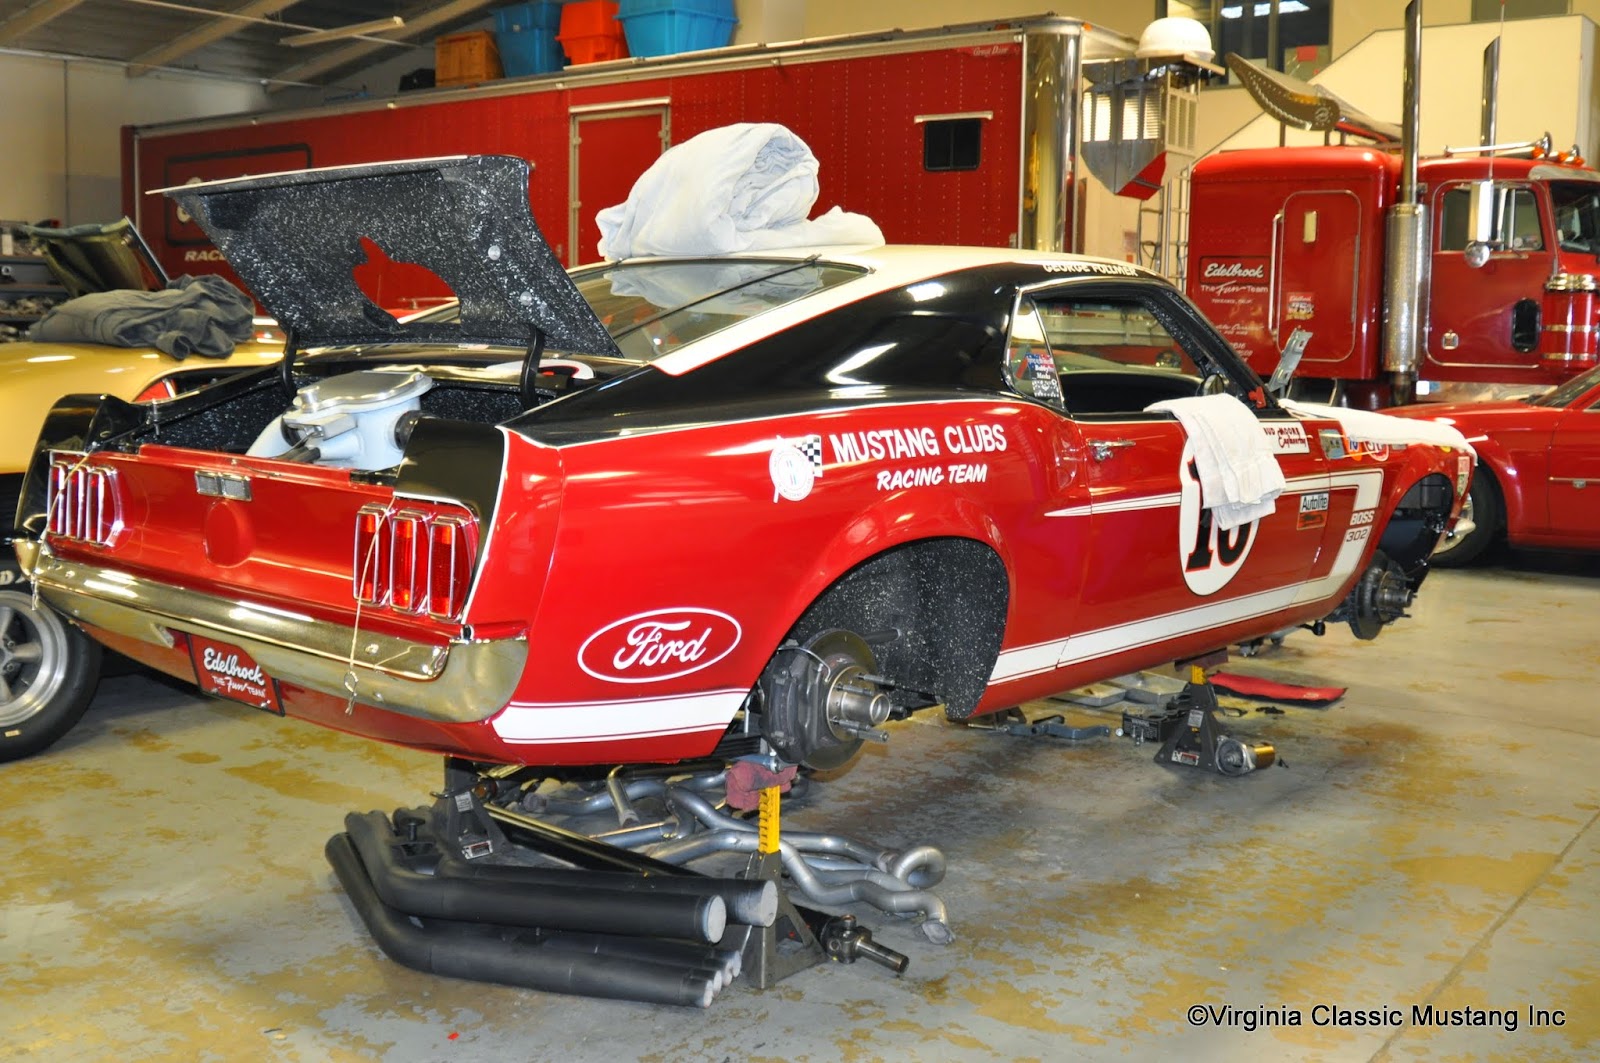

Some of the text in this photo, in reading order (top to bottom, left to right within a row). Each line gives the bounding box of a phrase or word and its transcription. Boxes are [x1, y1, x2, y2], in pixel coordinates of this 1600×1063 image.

[184, 250, 227, 262] RAC
[1204, 262, 1263, 278] Edelbrock
[1200, 280, 1268, 296] The Fun Team
[829, 424, 1007, 463] MUSTANG CLUBS
[876, 463, 988, 491] RACING TEAM
[1301, 493, 1329, 511] Autolite
[1350, 510, 1375, 526] BOSS
[1346, 528, 1368, 542] 302
[612, 620, 712, 670] Ford
[203, 647, 265, 686] Edelbrock
